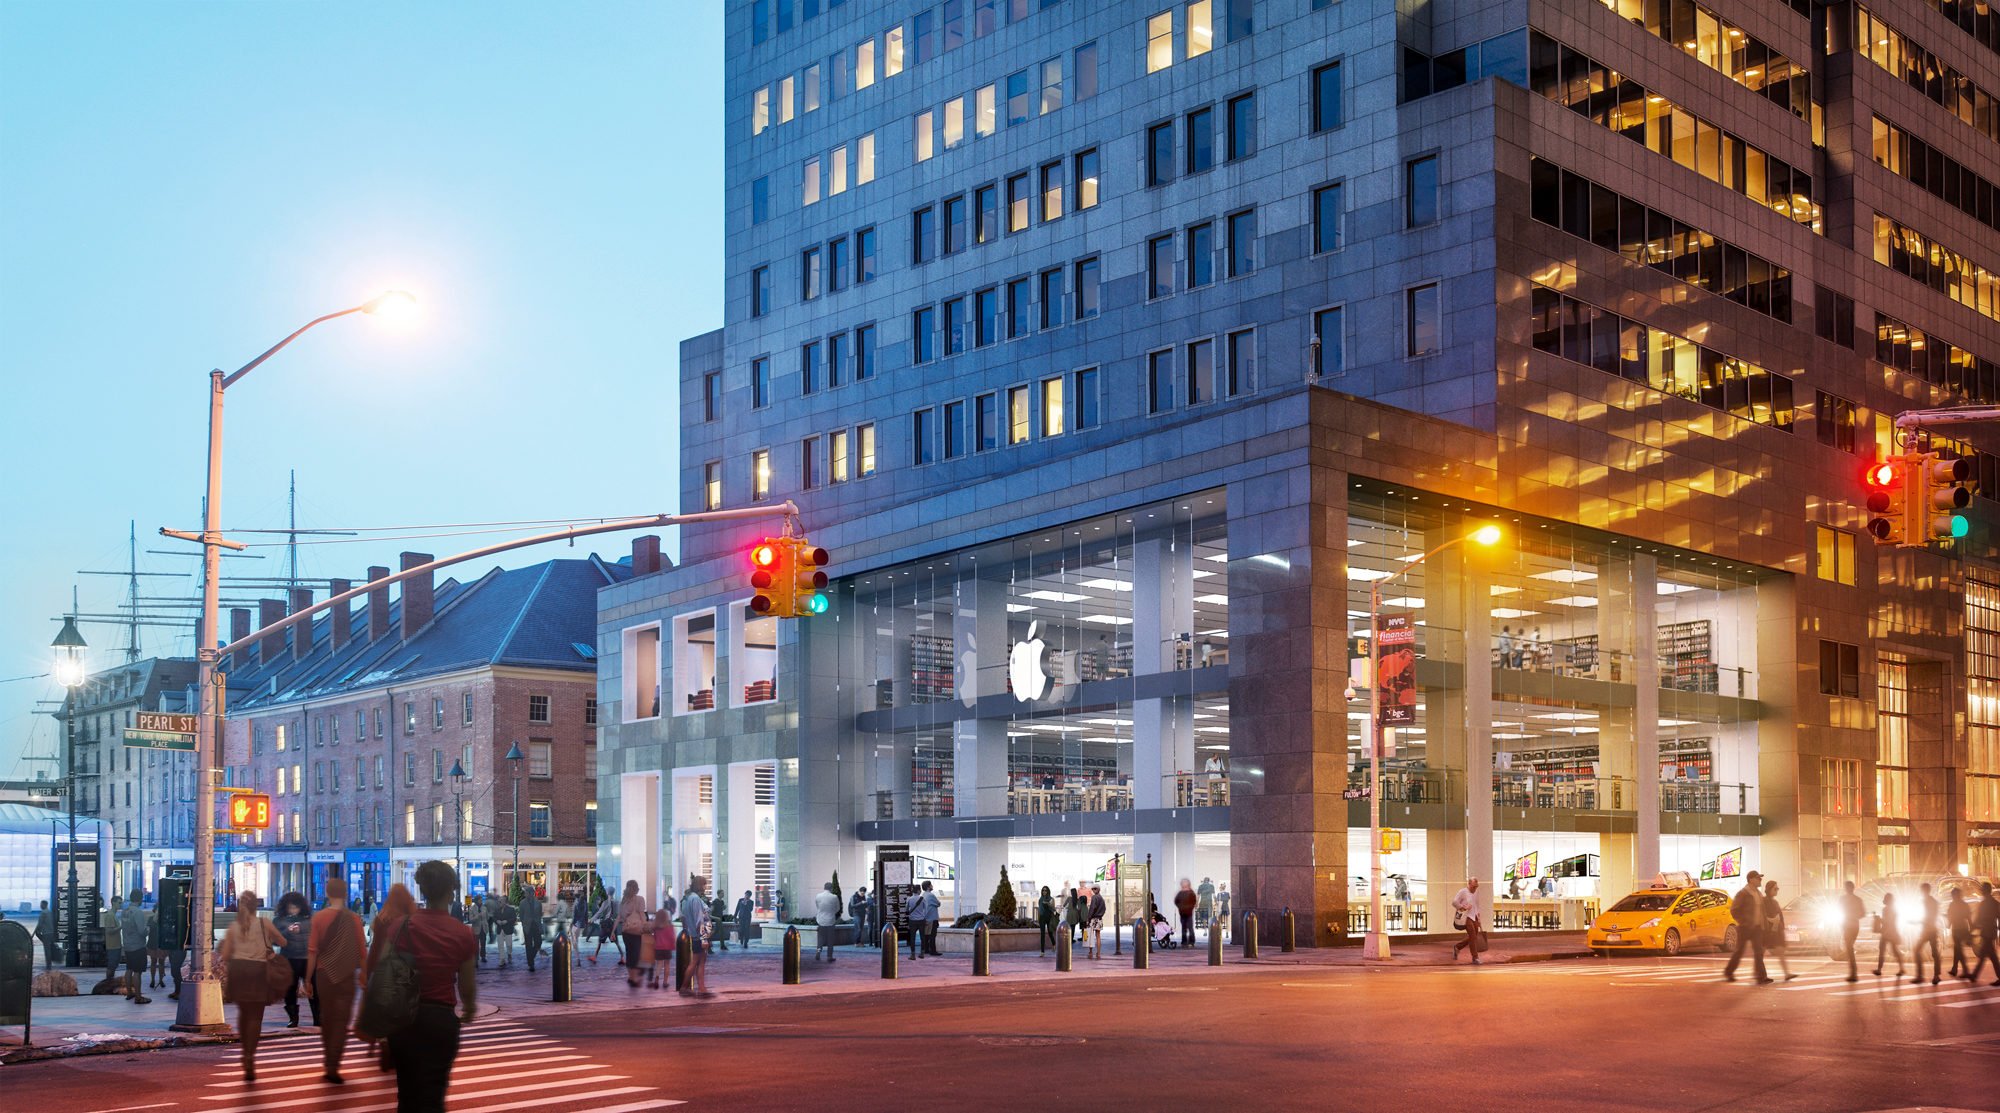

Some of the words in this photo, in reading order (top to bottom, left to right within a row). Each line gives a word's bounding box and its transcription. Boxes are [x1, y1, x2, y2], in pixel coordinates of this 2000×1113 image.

[1389, 618, 1405, 626] NYC
[1379, 630, 1414, 641] financial
[140, 715, 175, 730] PEARL
[181, 717, 193, 731] ST
[150, 740, 169, 748] PLACE
[29, 788, 52, 796] WATER
[56, 788, 66, 796] ST
